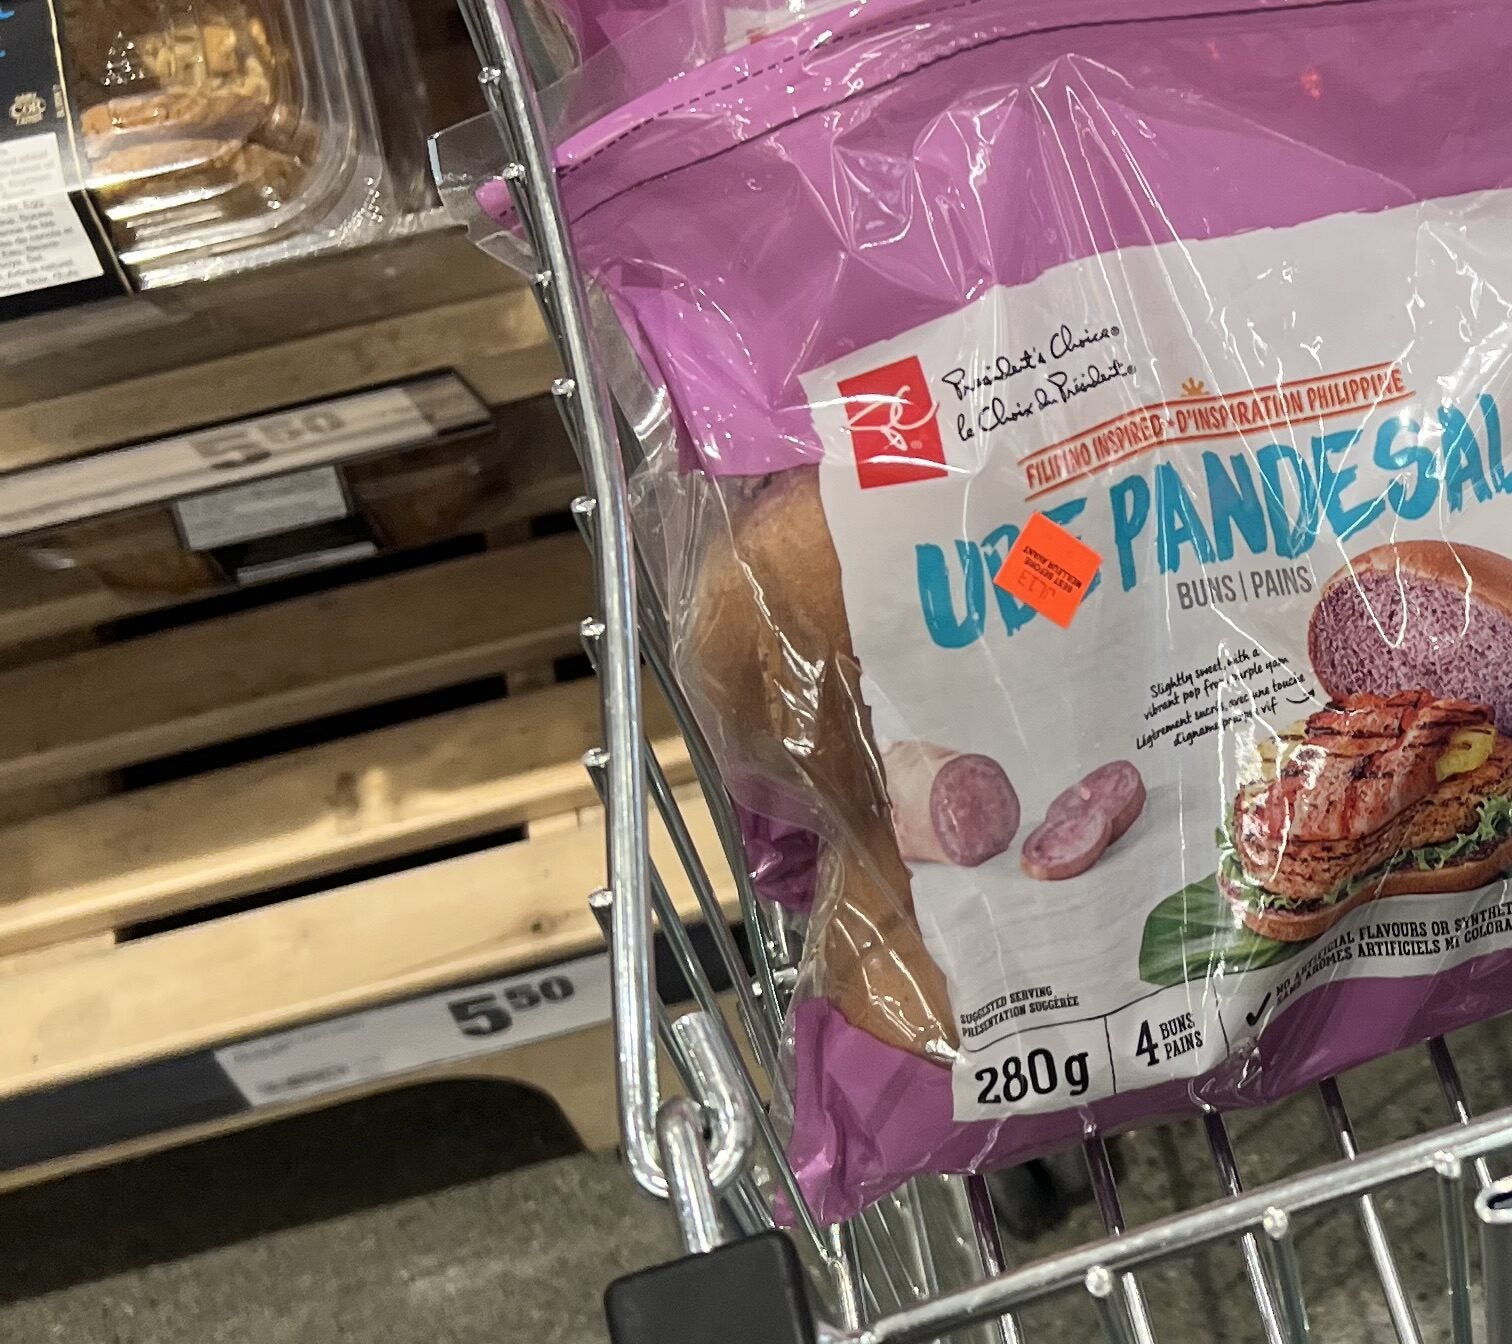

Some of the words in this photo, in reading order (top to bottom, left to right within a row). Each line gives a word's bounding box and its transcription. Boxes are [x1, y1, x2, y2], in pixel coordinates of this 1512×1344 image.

[1091, 413, 1166, 460] INSPIRED
[1176, 391, 1304, 435] D'INSPIRATION
[1307, 371, 1406, 411] PHILIPPINE
[1177, 571, 1240, 612] BUNS
[1252, 562, 1314, 599] PAINS
[1149, 671, 1193, 698] Slightly
[1143, 694, 1180, 721] vibrant
[1183, 685, 1201, 705] pop
[1260, 696, 1279, 715] vif
[1358, 921, 1428, 942] FLAVOURS
[1430, 918, 1451, 936] OR
[1357, 938, 1442, 959] ARTIFICIELS
[959, 994, 1008, 1026] SUGGESTED
[1009, 985, 1053, 1004] SERVING
[1135, 1019, 1161, 1067] 4
[1158, 1011, 1196, 1041] BUNS
[1163, 1030, 1204, 1061] PAINS
